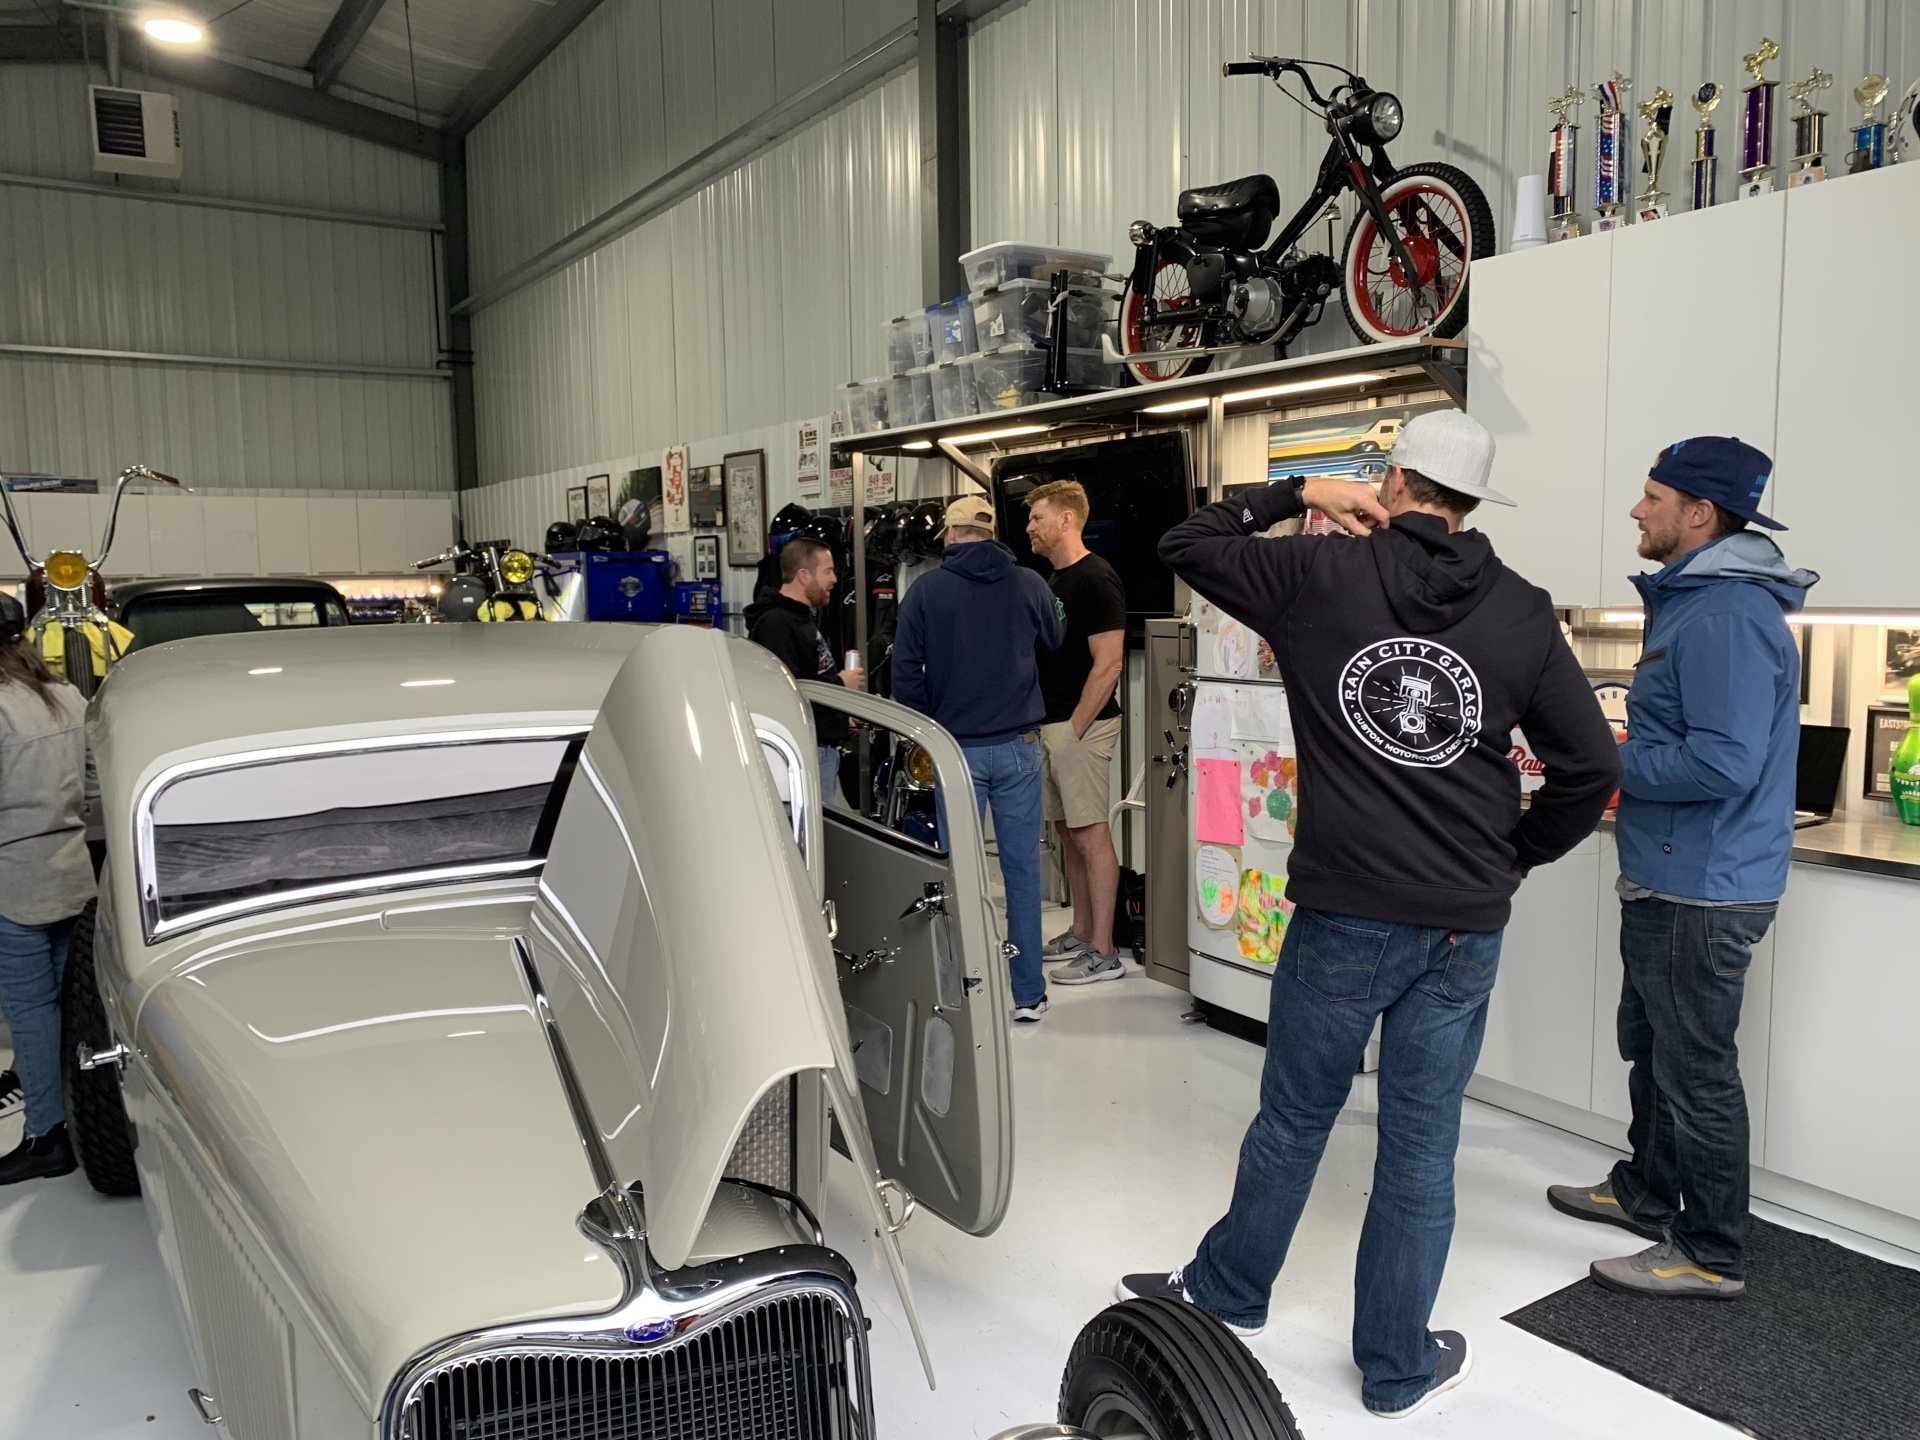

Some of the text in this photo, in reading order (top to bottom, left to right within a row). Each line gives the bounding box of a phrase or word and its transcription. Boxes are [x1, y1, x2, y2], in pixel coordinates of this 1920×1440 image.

[1344, 643, 1477, 731] RAIN CITY GARAGE
[1353, 713, 1383, 746] CUSTOM
[1384, 742, 1446, 762] MOTORCYCLE
